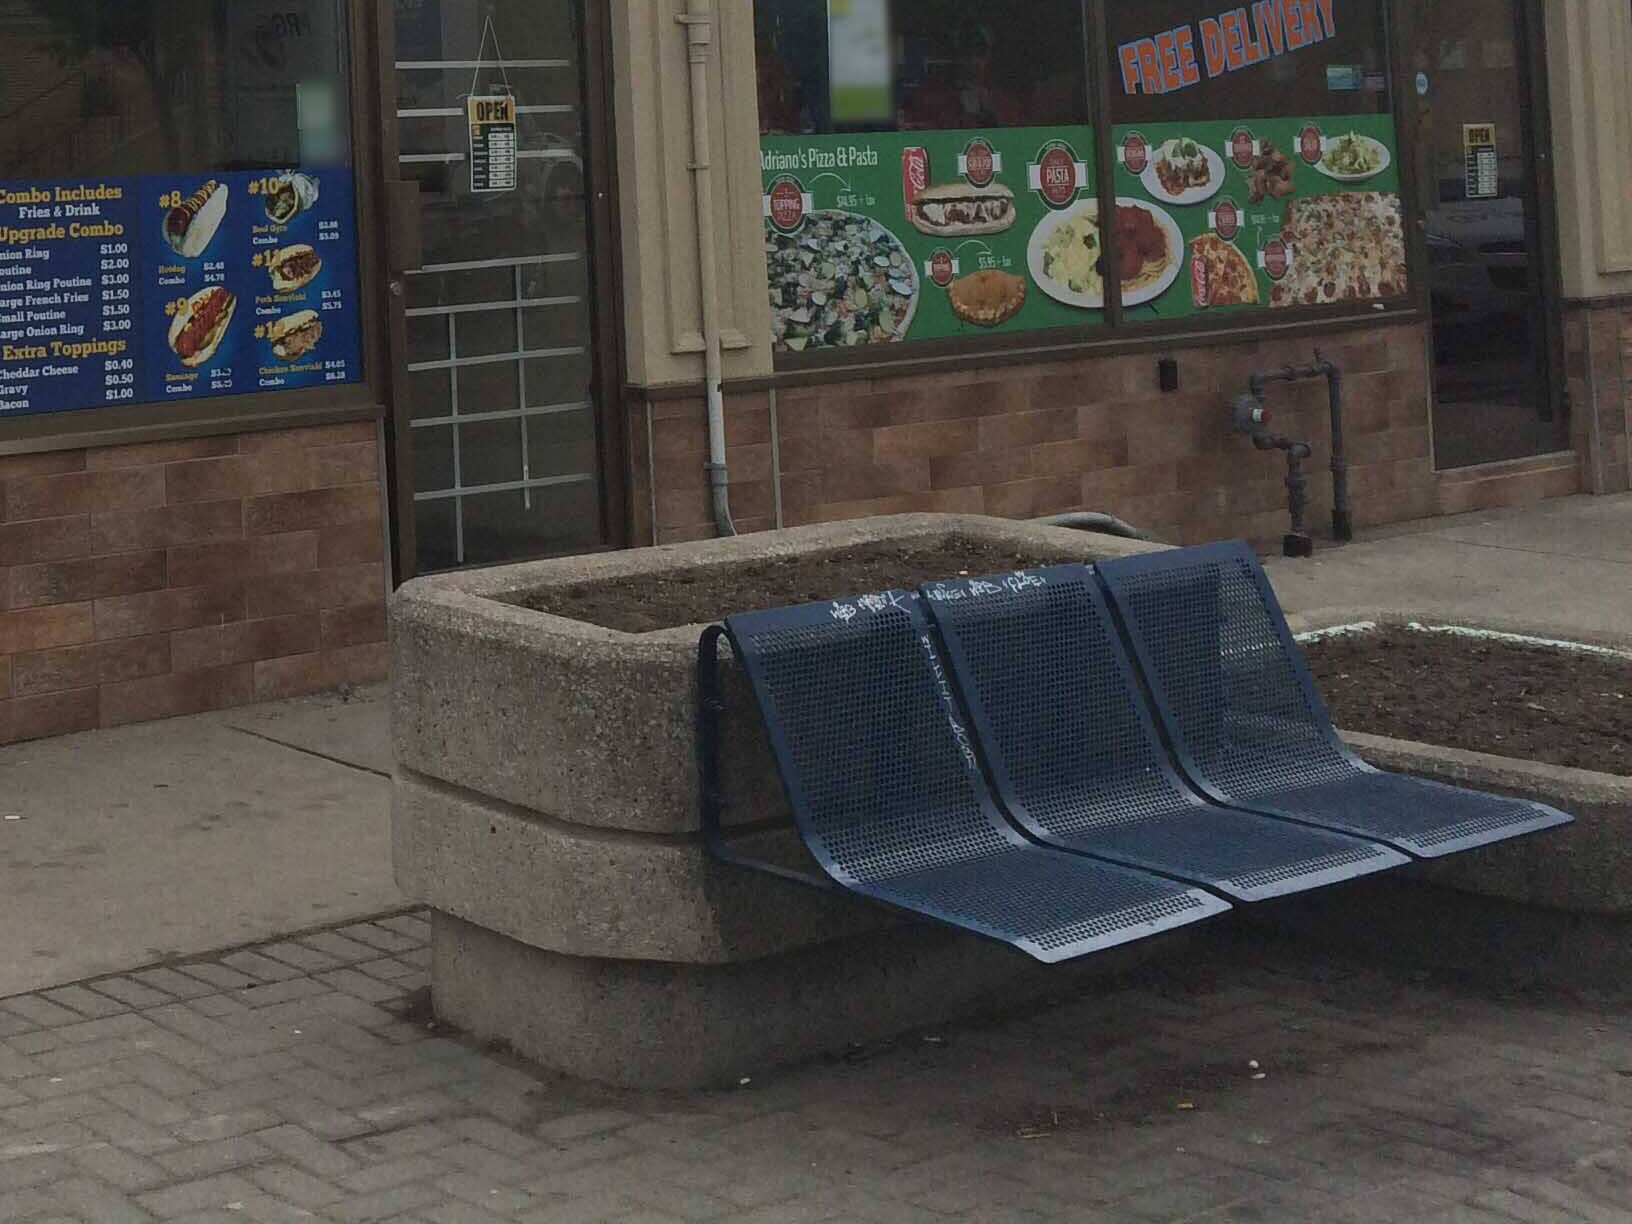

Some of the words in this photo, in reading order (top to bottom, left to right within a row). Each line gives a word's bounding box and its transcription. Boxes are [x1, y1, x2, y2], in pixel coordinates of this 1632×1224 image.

[1118, 25, 1201, 95] FREE
[476, 101, 508, 121] OPEN
[808, 147, 835, 168] Pizza
[836, 146, 848, 167] &
[848, 145, 878, 166] Pasta
[55, 184, 122, 201] Includes
[248, 178, 280, 194] #10
[159, 191, 181, 209] #8
[19, 205, 50, 219] Fries
[53, 206, 62, 217] &
[65, 202, 100, 216] Drink
[69, 220, 124, 238] Combo
[25, 246, 50, 260] Ring
[100, 243, 128, 255] $1.00
[101, 258, 129, 270] $2.00
[26, 279, 51, 291] Ring
[53, 276, 92, 288] Poutine
[158, 275, 186, 285] Combo
[25, 293, 62, 306] French
[63, 292, 89, 303] Fries
[102, 289, 129, 300] $1.50
[26, 309, 66, 321] Poutine
[102, 304, 130, 316] $1.50
[165, 297, 189, 316] #9
[26, 325, 57, 337] Onion
[59, 323, 84, 335] Ring
[2, 345, 47, 360] Extra
[50, 337, 126, 359] Toppings
[41, 365, 79, 376] Cheese
[105, 373, 134, 386] $0.50
[105, 388, 133, 400] $1.00
